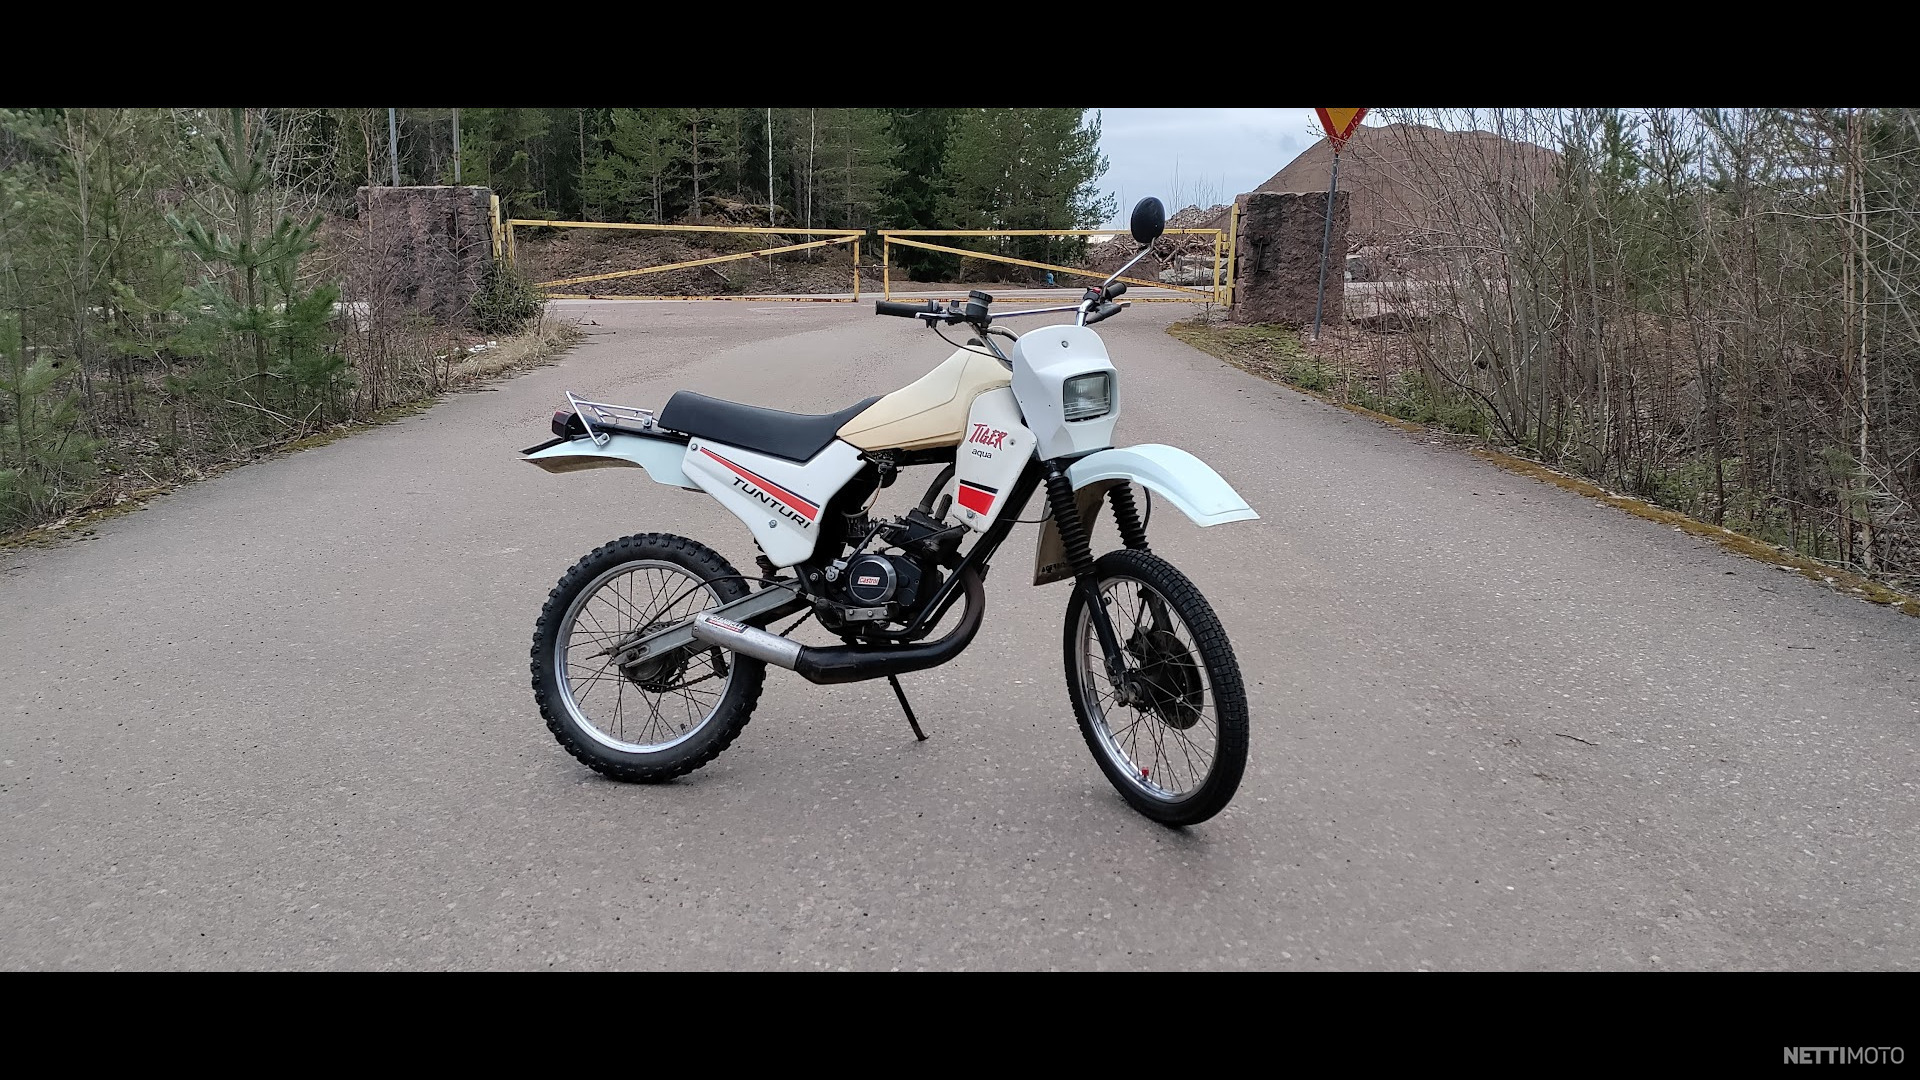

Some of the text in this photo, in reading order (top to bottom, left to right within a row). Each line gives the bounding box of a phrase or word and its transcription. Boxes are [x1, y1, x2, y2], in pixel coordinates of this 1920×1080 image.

[968, 423, 1008, 451] TIGER
[971, 448, 992, 459] aqua
[733, 476, 811, 529] TUNTURI
[859, 577, 879, 585] Castrol
